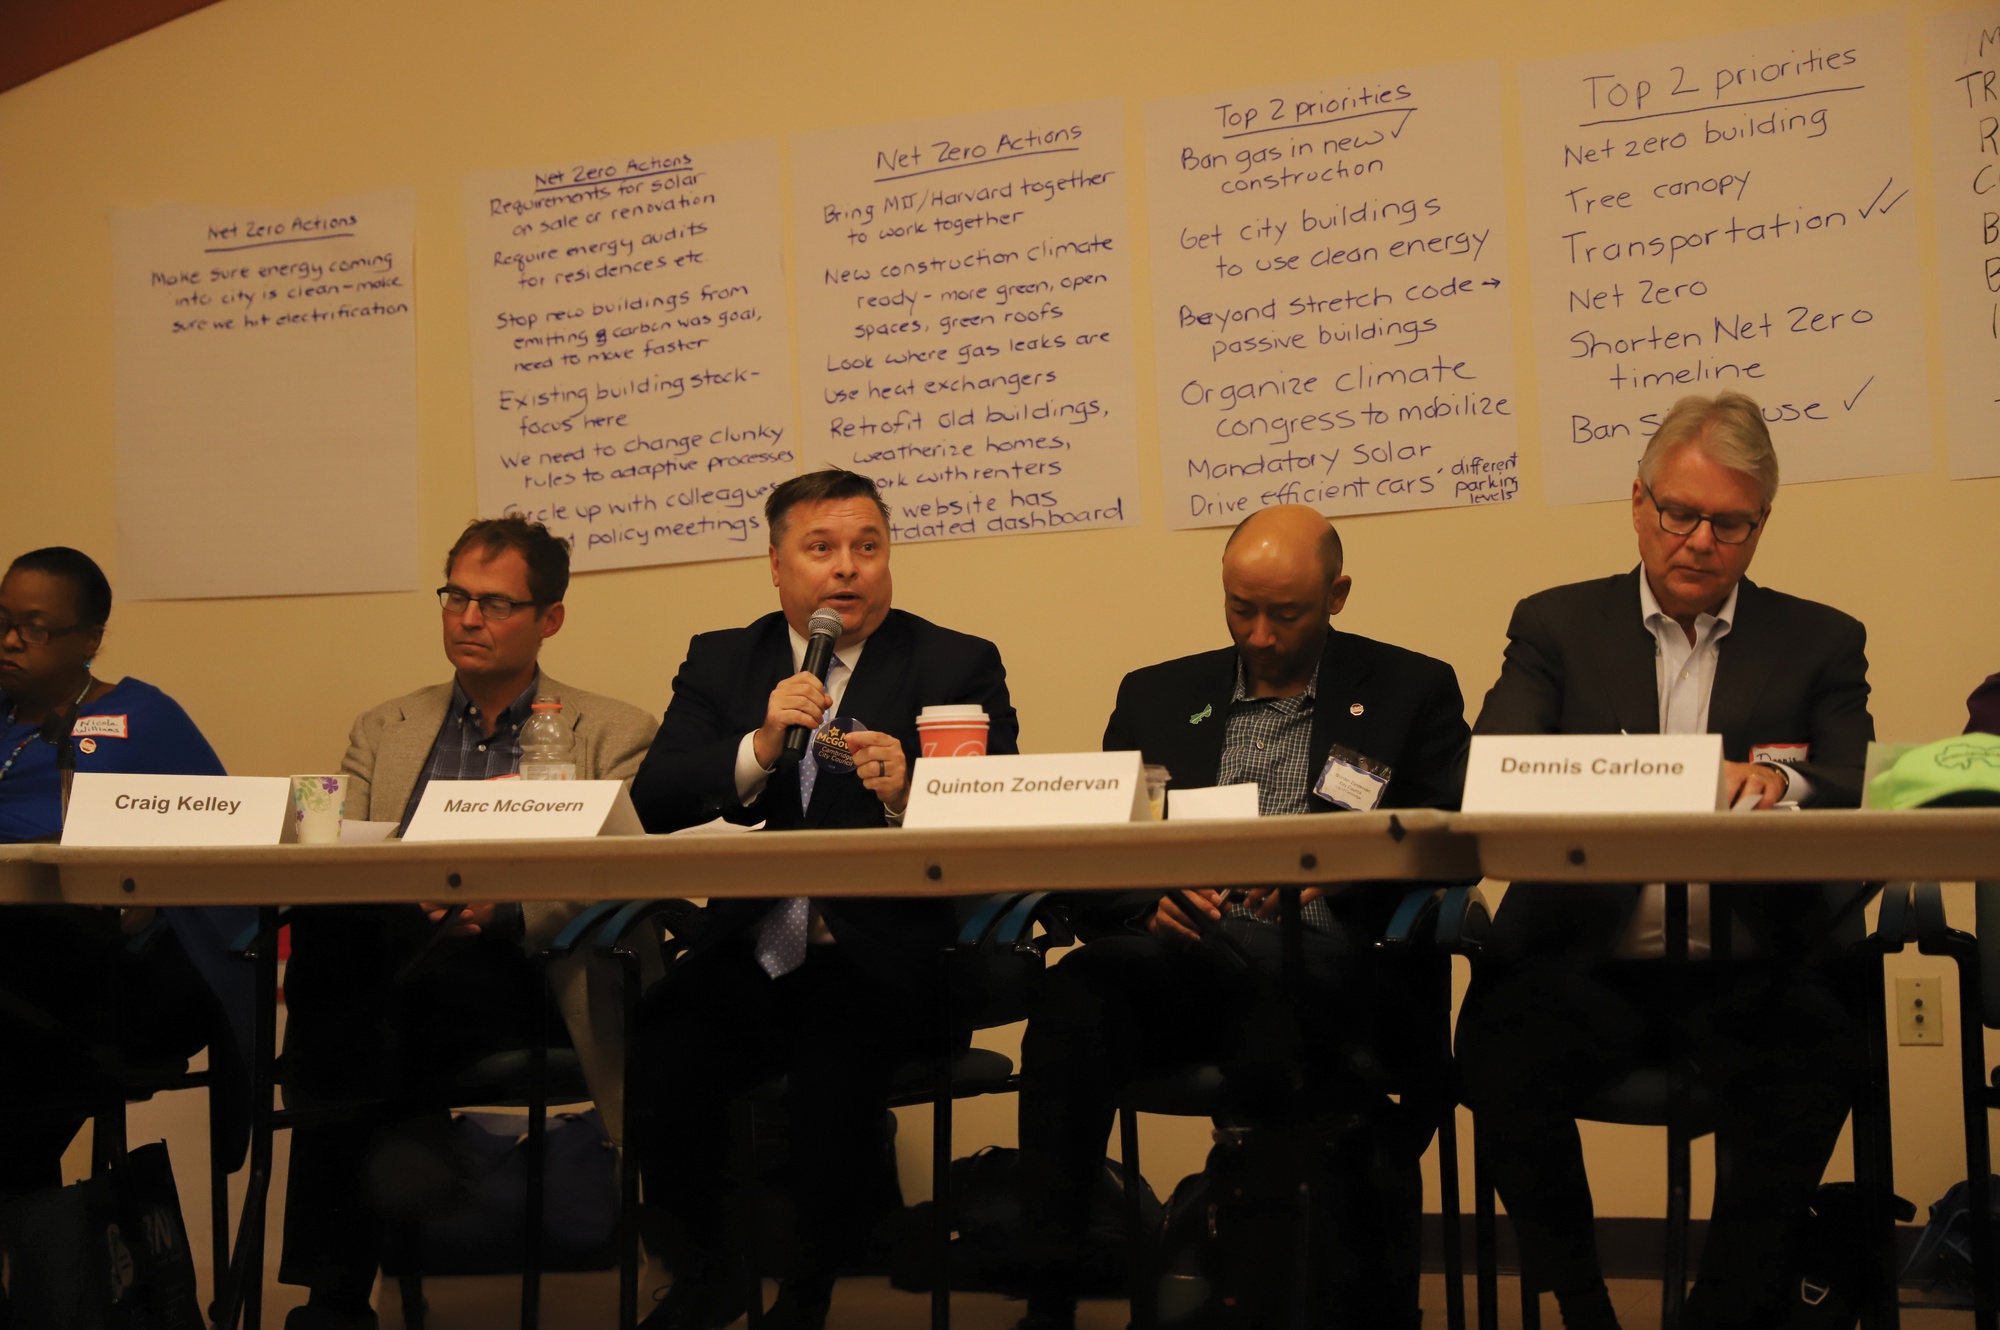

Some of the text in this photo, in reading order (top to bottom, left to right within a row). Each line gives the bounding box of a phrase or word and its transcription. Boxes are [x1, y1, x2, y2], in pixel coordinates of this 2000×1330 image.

[1583, 49, 1856, 110] Top 2 priorities
[1214, 84, 1411, 130] Top 2 priorities
[877, 125, 1082, 171] Net Zero Actions
[1565, 109, 1827, 167] Net zero building
[535, 154, 692, 186] Net Zero Actions
[1181, 147, 1227, 171] Ban
[1235, 147, 1282, 174] gas
[1291, 138, 1313, 158] in
[1221, 159, 1383, 194] construction
[1565, 171, 1751, 214] Tree canopy
[490, 185, 611, 217] Requirements
[651, 172, 705, 193] solar
[824, 204, 874, 226] Bring
[1020, 170, 1115, 202] together
[208, 215, 357, 239] Net Zero Actions
[540, 215, 578, 233] sale
[611, 194, 715, 220] renovation
[847, 211, 1024, 245] to work together
[1180, 198, 1441, 250] Get city buildings
[493, 222, 708, 271] Require energy audits
[1562, 206, 1846, 264] Transportation
[151, 253, 393, 286] Make sure energy coming
[555, 256, 667, 284] residences
[825, 234, 1113, 285] New construction climate
[1216, 255, 1243, 278] to
[1310, 247, 1378, 267] clean
[1389, 229, 1489, 262] energy
[221, 290, 254, 309] city
[263, 289, 278, 300] is
[941, 287, 988, 301] more
[1060, 274, 1107, 291] open
[1570, 280, 1707, 312] Net Zero
[213, 319, 233, 330] we
[275, 302, 408, 326] electrification
[496, 312, 538, 330] Stop
[592, 291, 690, 316] buildings
[700, 284, 749, 301] from
[939, 315, 995, 335] green
[1004, 302, 1063, 323] roofs
[1179, 276, 1473, 333] Beyond code
[677, 315, 712, 328] was
[1570, 306, 1873, 358] Shorten Net Zero
[560, 339, 709, 365] to faster
[827, 332, 1110, 372] Look where gas leaks are
[1212, 318, 1437, 362] passive buildings
[868, 371, 1056, 400] heat exchangers
[1181, 370, 1318, 411] Organize
[1609, 360, 1765, 390] timeline
[500, 386, 589, 418] Existing
[597, 374, 685, 400] building
[520, 414, 628, 436] focus here
[830, 410, 922, 438] Retrofit
[1216, 392, 1511, 445] congress to mobilize
[1571, 415, 1630, 444] Ban
[500, 424, 783, 469] We need to change clunky
[853, 436, 1071, 464] weatherize homes,
[1451, 451, 1518, 475] different
[525, 450, 794, 488] rules to adaptive processes
[916, 461, 1062, 484] with renters
[1188, 449, 1339, 479] Mandatory
[1191, 476, 1370, 517] Drive efficient
[1455, 472, 1519, 501] parking
[1470, 489, 1513, 504] levels
[576, 505, 602, 523] up
[608, 495, 657, 515] with
[902, 489, 1058, 518] website has
[987, 497, 1124, 533] dashboard
[588, 528, 649, 550] policy
[654, 516, 760, 542] meetings
[817, 732, 849, 749] McGov
[1501, 757, 1684, 775] Dennis Carlone
[926, 776, 1119, 796] Quinton Zondervan
[115, 794, 241, 815] Craig Kelley
[444, 799, 584, 813] Marc McGovern
